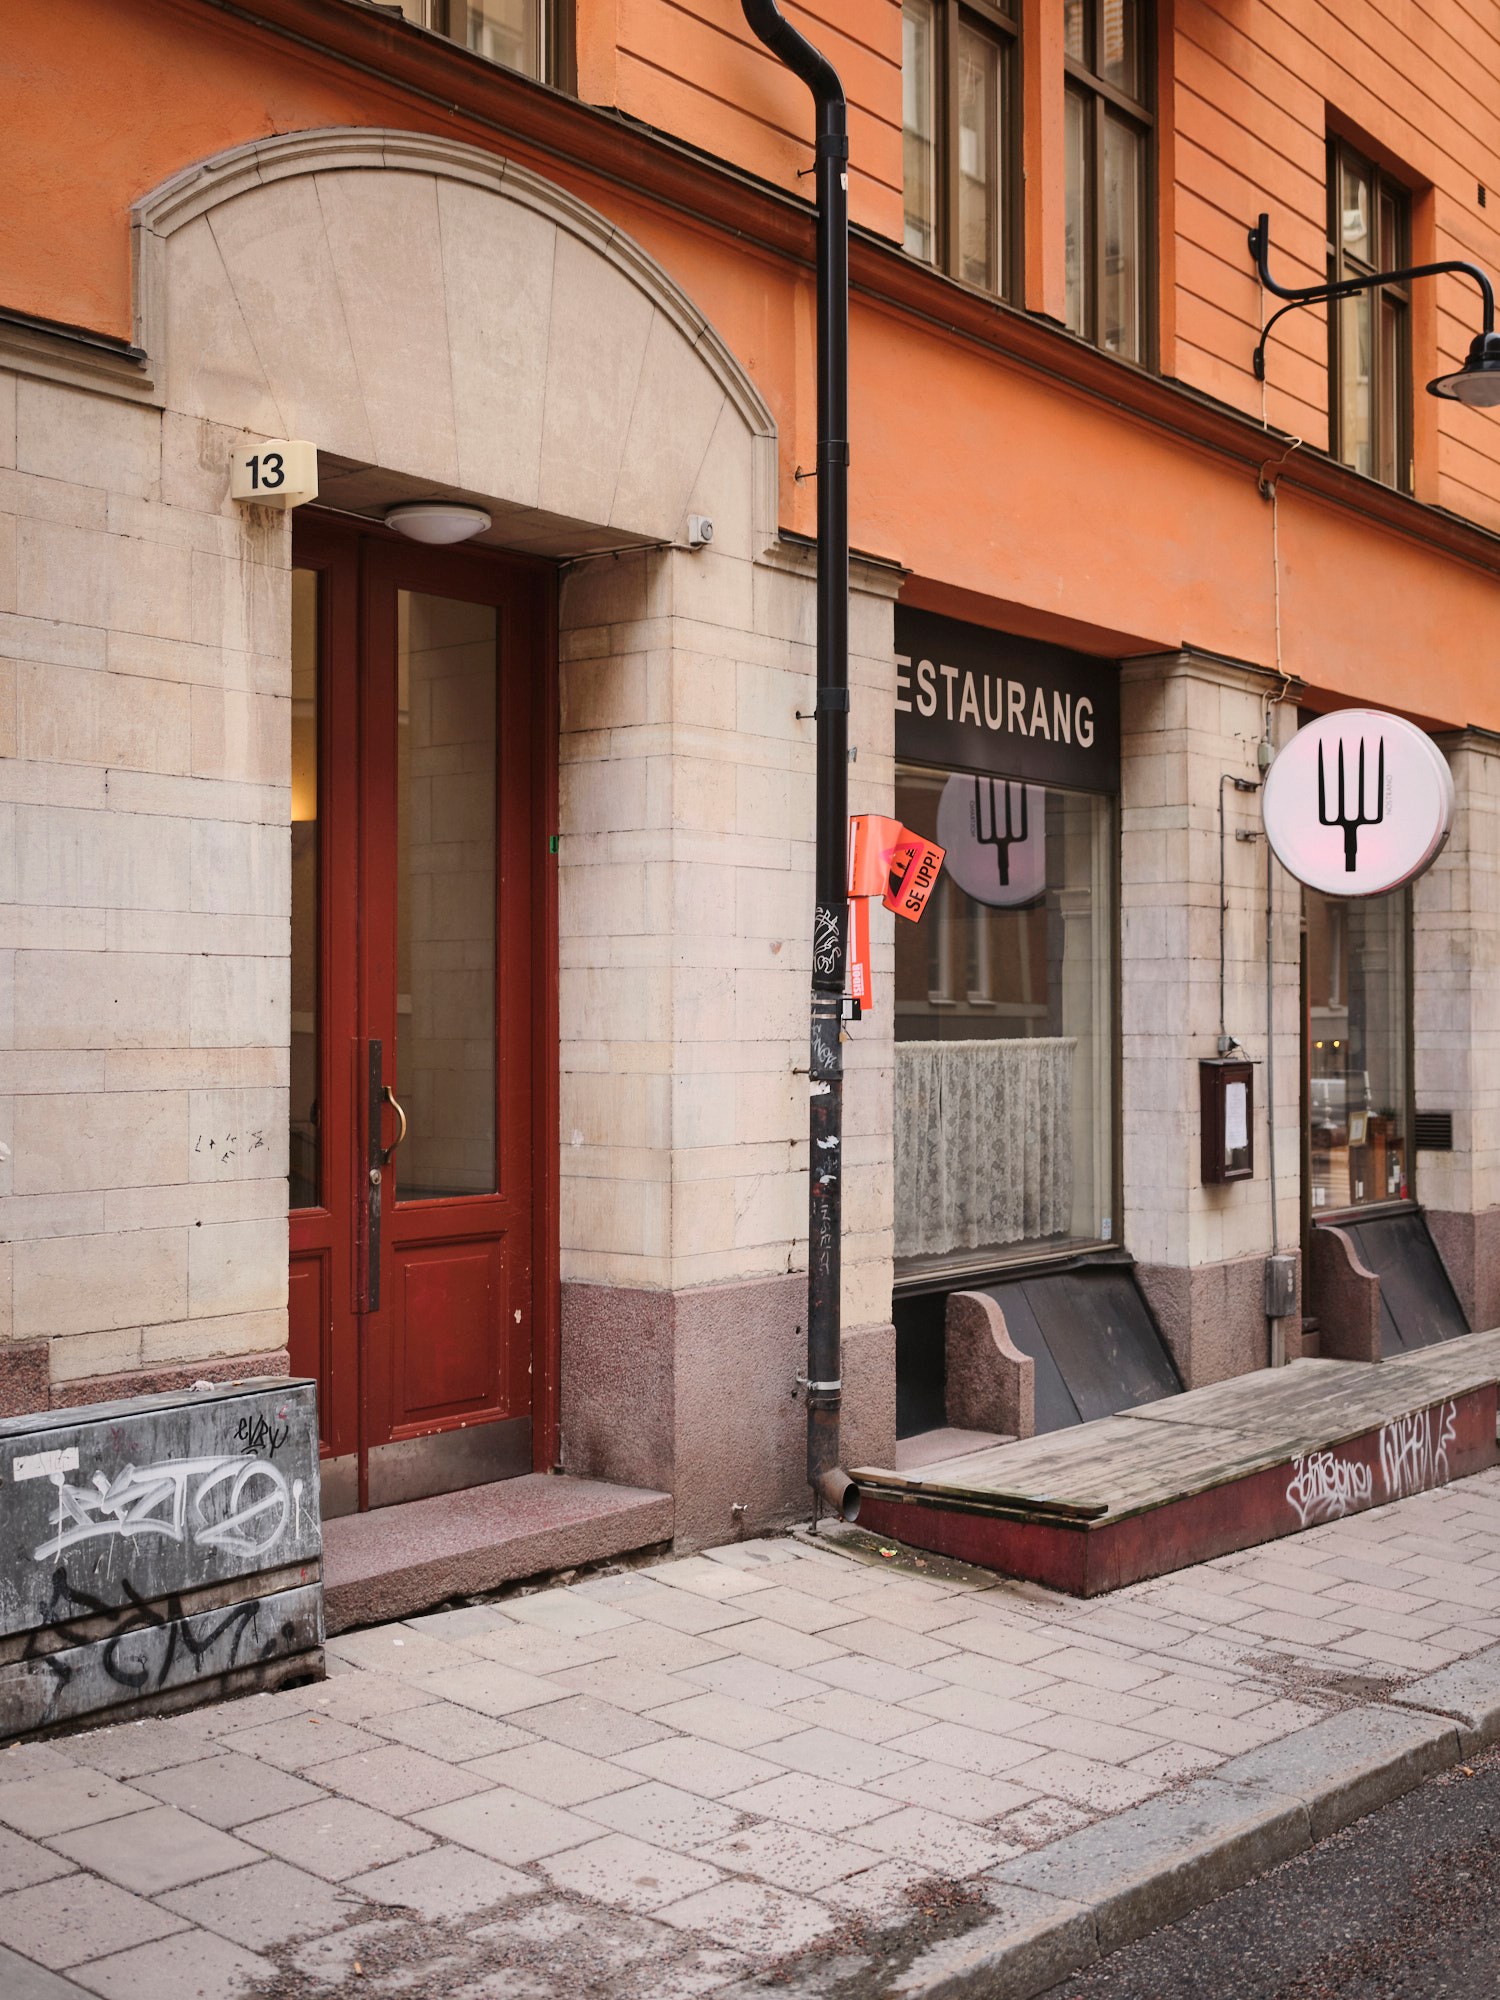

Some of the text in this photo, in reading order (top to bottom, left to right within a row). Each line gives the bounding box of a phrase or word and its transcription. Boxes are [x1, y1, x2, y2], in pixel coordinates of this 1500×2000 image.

[246, 453, 285, 489] 13
[895, 653, 1094, 748] ESTAURANG
[905, 851, 940, 912] SE UPP!
[852, 963, 864, 996] ISIDOR
